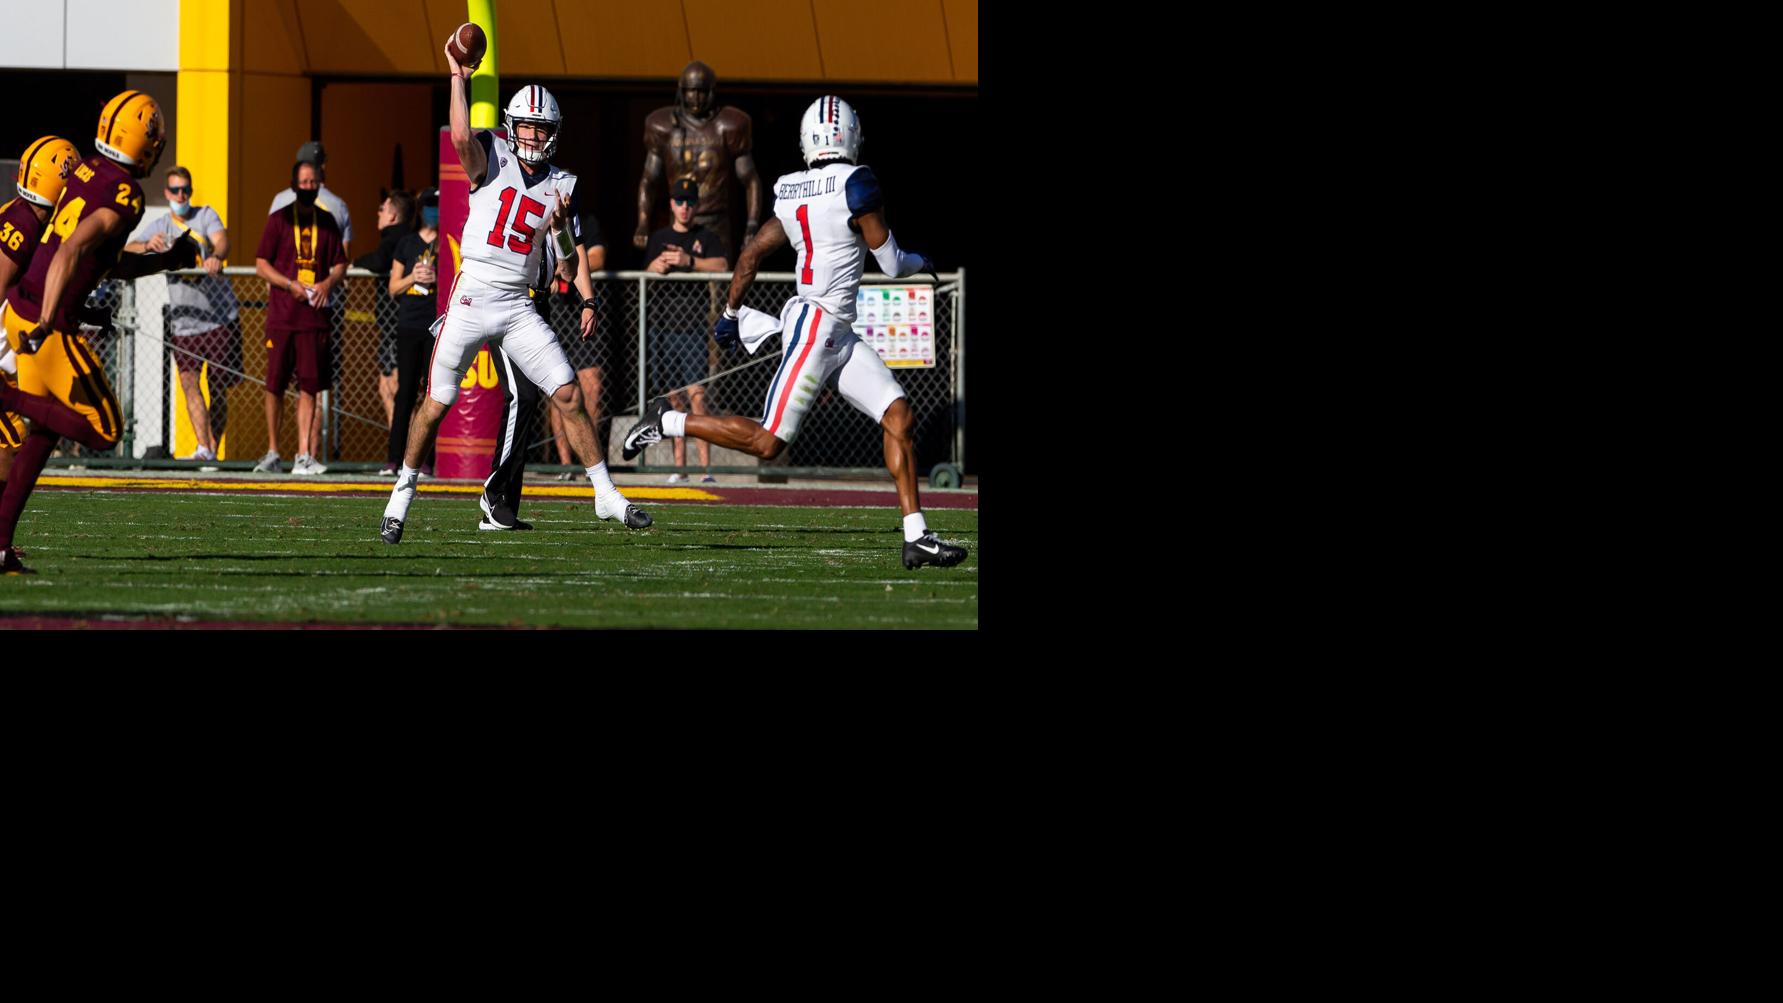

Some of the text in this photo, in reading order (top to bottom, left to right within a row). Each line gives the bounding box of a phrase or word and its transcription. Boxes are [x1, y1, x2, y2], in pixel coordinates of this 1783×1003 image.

[779, 175, 836, 200] BERRYHILL III
[0, 221, 24, 251] 36
[487, 186, 546, 256] 15
[796, 204, 814, 285] 1
